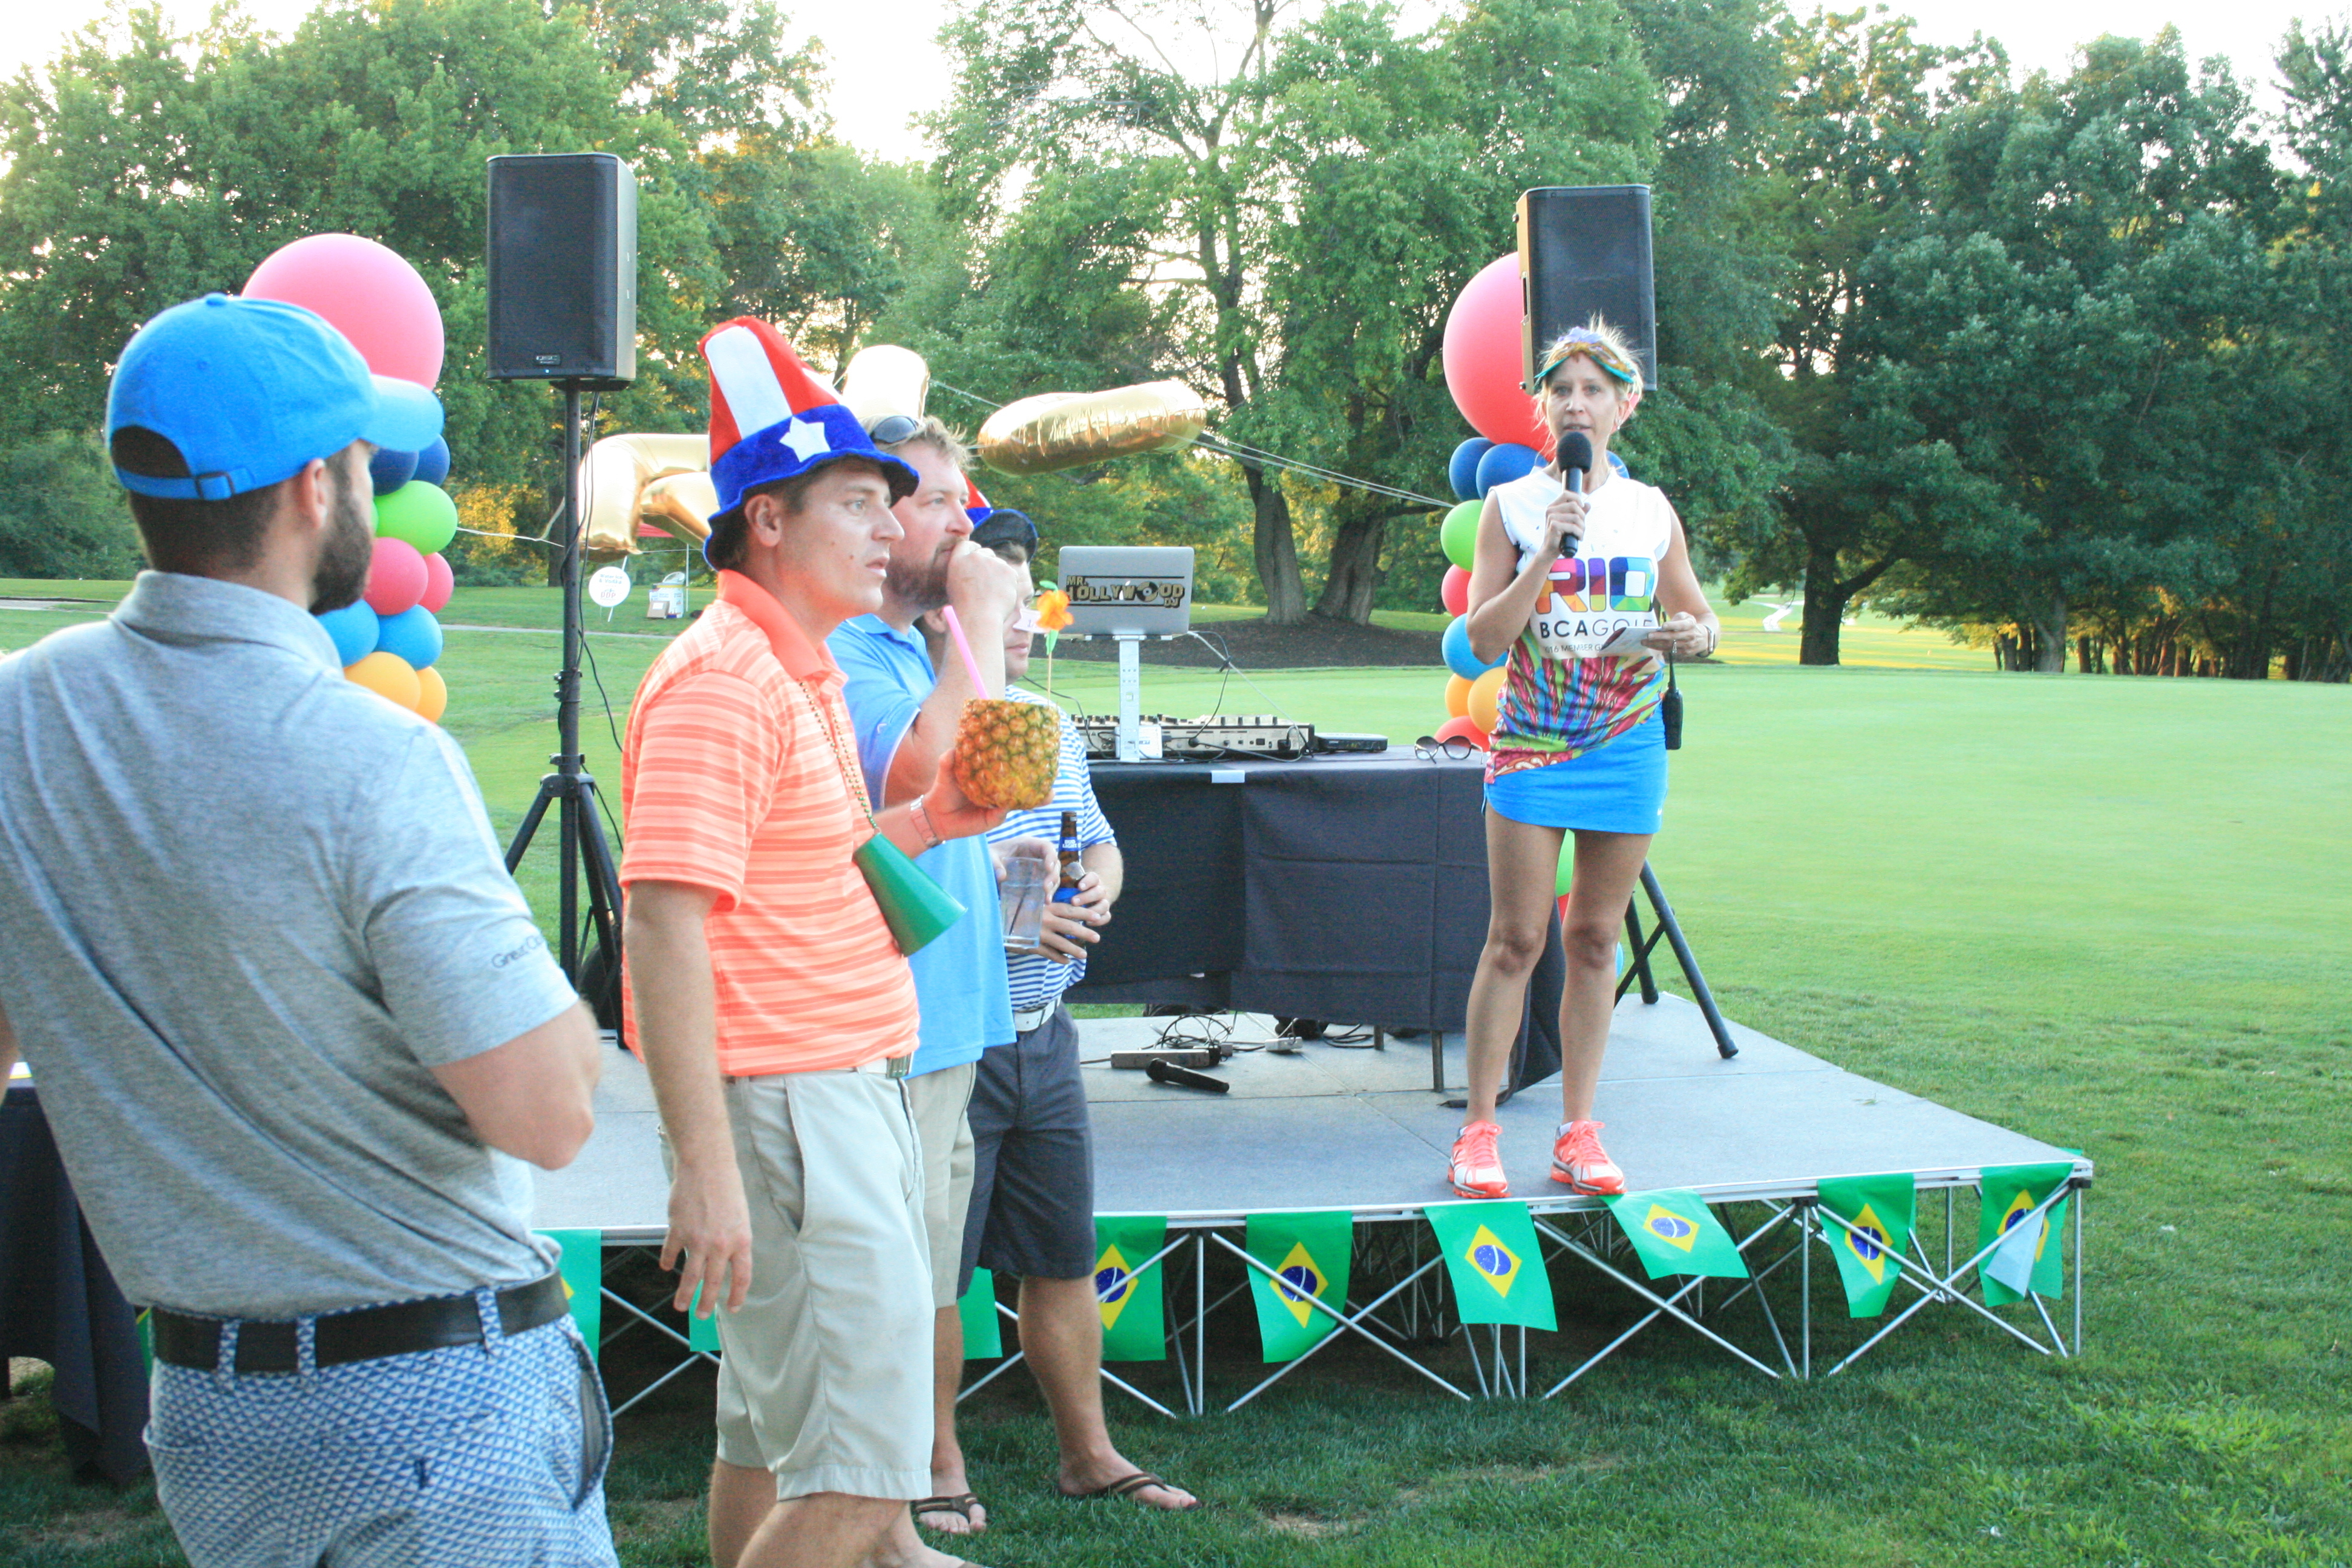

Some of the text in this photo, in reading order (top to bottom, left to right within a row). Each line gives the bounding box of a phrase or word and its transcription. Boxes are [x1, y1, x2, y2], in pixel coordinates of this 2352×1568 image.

[1067, 575, 1088, 586] MR.
[1535, 557, 1655, 614] RIO
[1164, 598, 1180, 609] DJ
[1561, 644, 1593, 652] MEMBER
